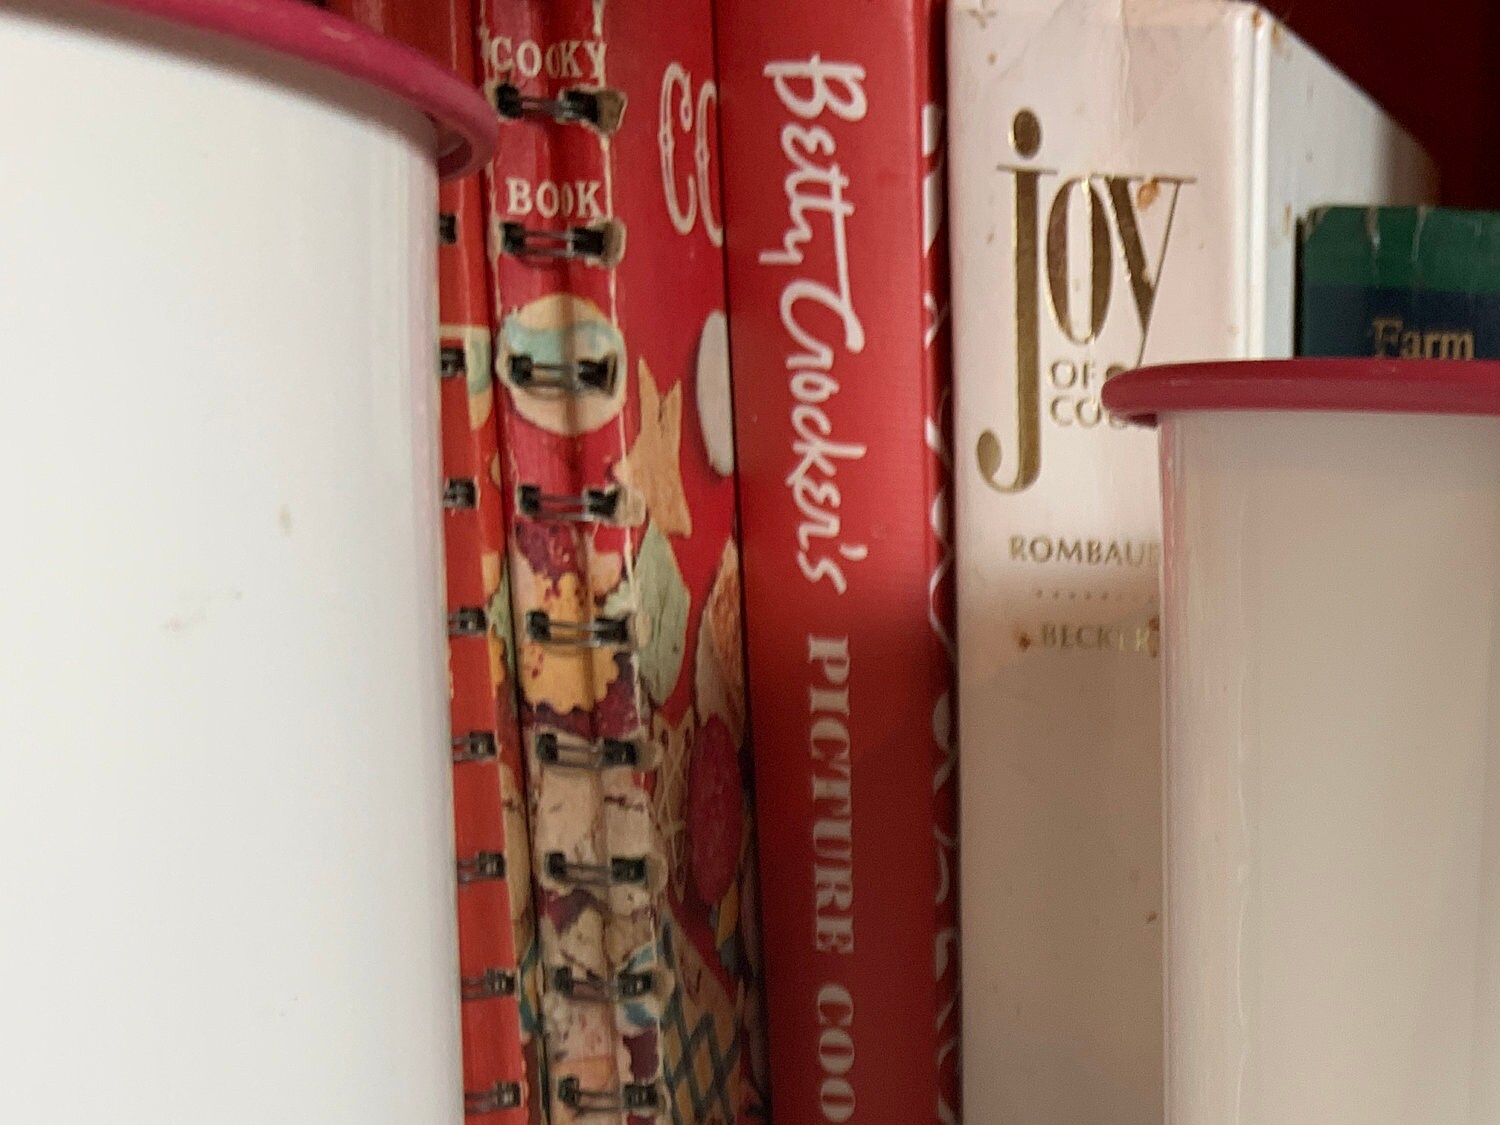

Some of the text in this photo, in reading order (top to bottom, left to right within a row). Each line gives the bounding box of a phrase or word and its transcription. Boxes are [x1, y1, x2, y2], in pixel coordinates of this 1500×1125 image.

[489, 35, 608, 79] COOKY
[506, 177, 602, 219] BOOK
[759, 53, 867, 266] Betty
[976, 107, 1198, 494] joy
[1371, 316, 1476, 361] Farm
[780, 278, 869, 596] Crocker's
[1050, 394, 1130, 429] CO
[808, 634, 855, 955] PICTURE
